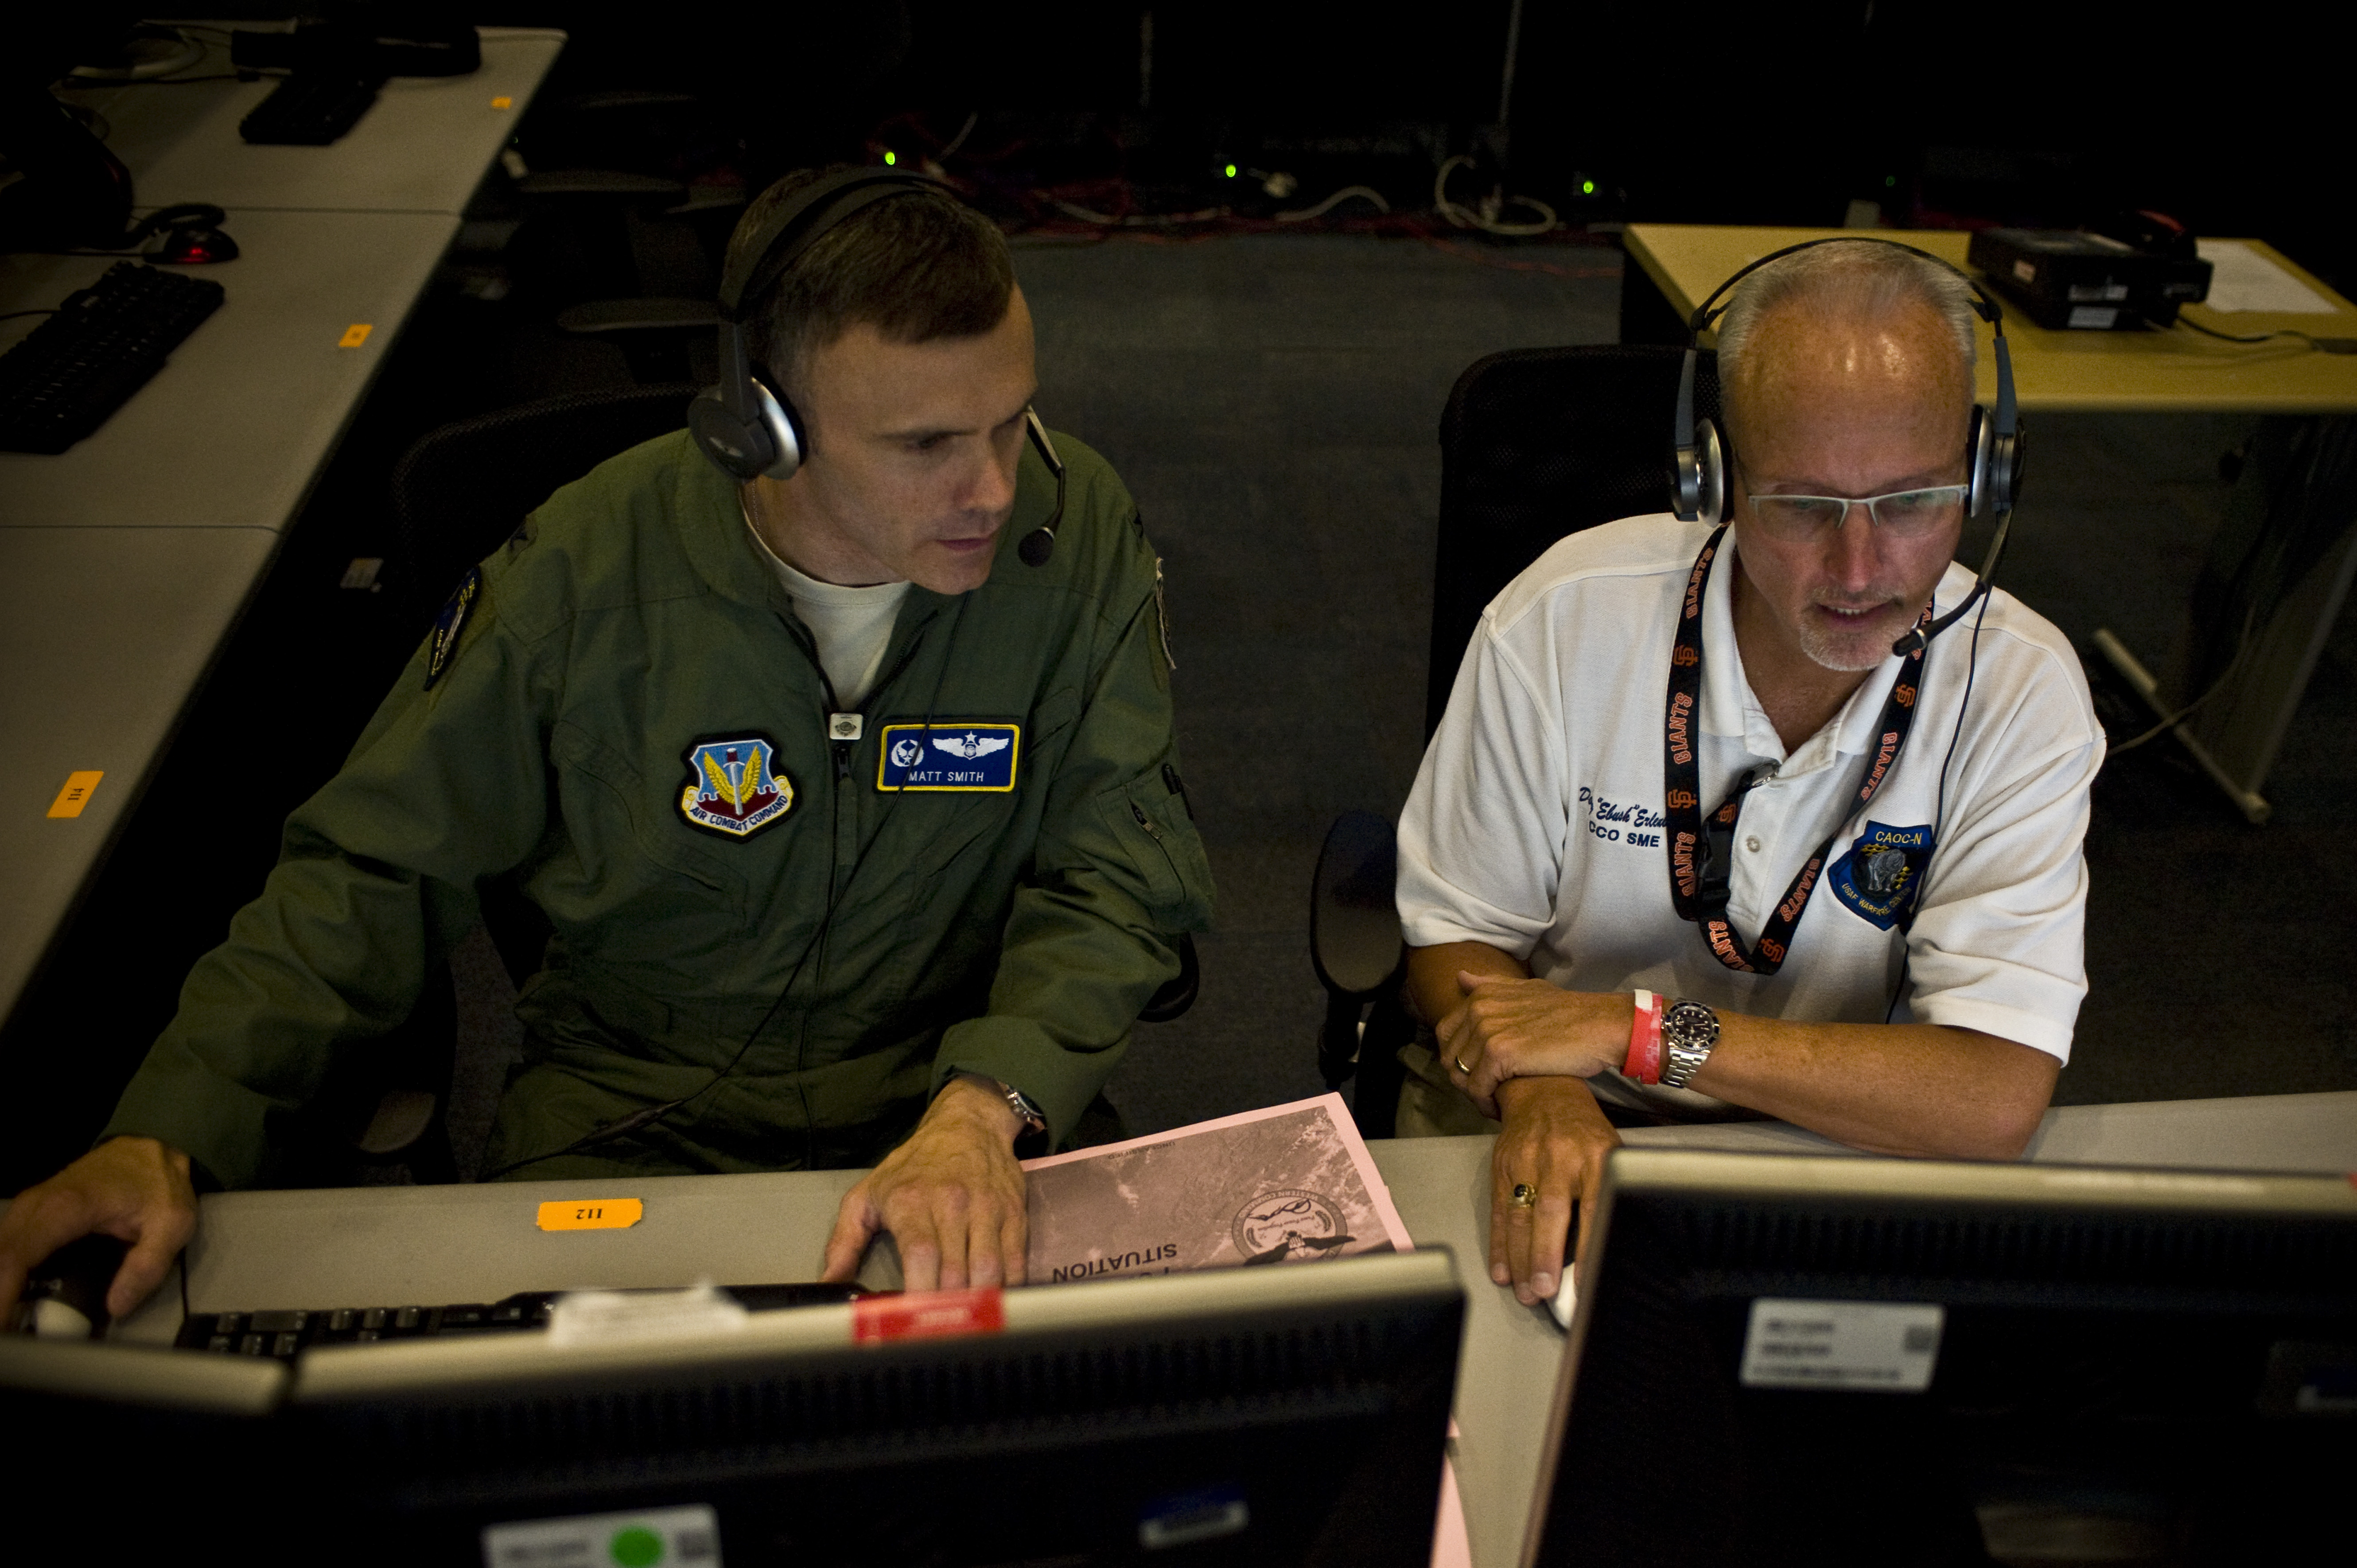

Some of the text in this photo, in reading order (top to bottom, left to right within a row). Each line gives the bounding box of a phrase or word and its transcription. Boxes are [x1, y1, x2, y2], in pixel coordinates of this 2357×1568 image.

[1686, 547, 1714, 620] GIANTS
[1669, 692, 1693, 765] GIANTS
[908, 771, 984, 782] MATT SMITH
[1860, 732, 1898, 801] GIANTS
[689, 795, 788, 831] AIR COMBAT COMMAND
[1626, 832, 1660, 847] SME
[1875, 831, 1922, 845] CAOC-N
[1674, 831, 1696, 897] GIANTS
[1780, 858, 1820, 922] GIANTS
[1841, 882, 1859, 900] USAF
[1858, 897, 1891, 916] WARFARE
[576, 1208, 603, 1219] 112
[1053, 1243, 1177, 1283] SITUATION
